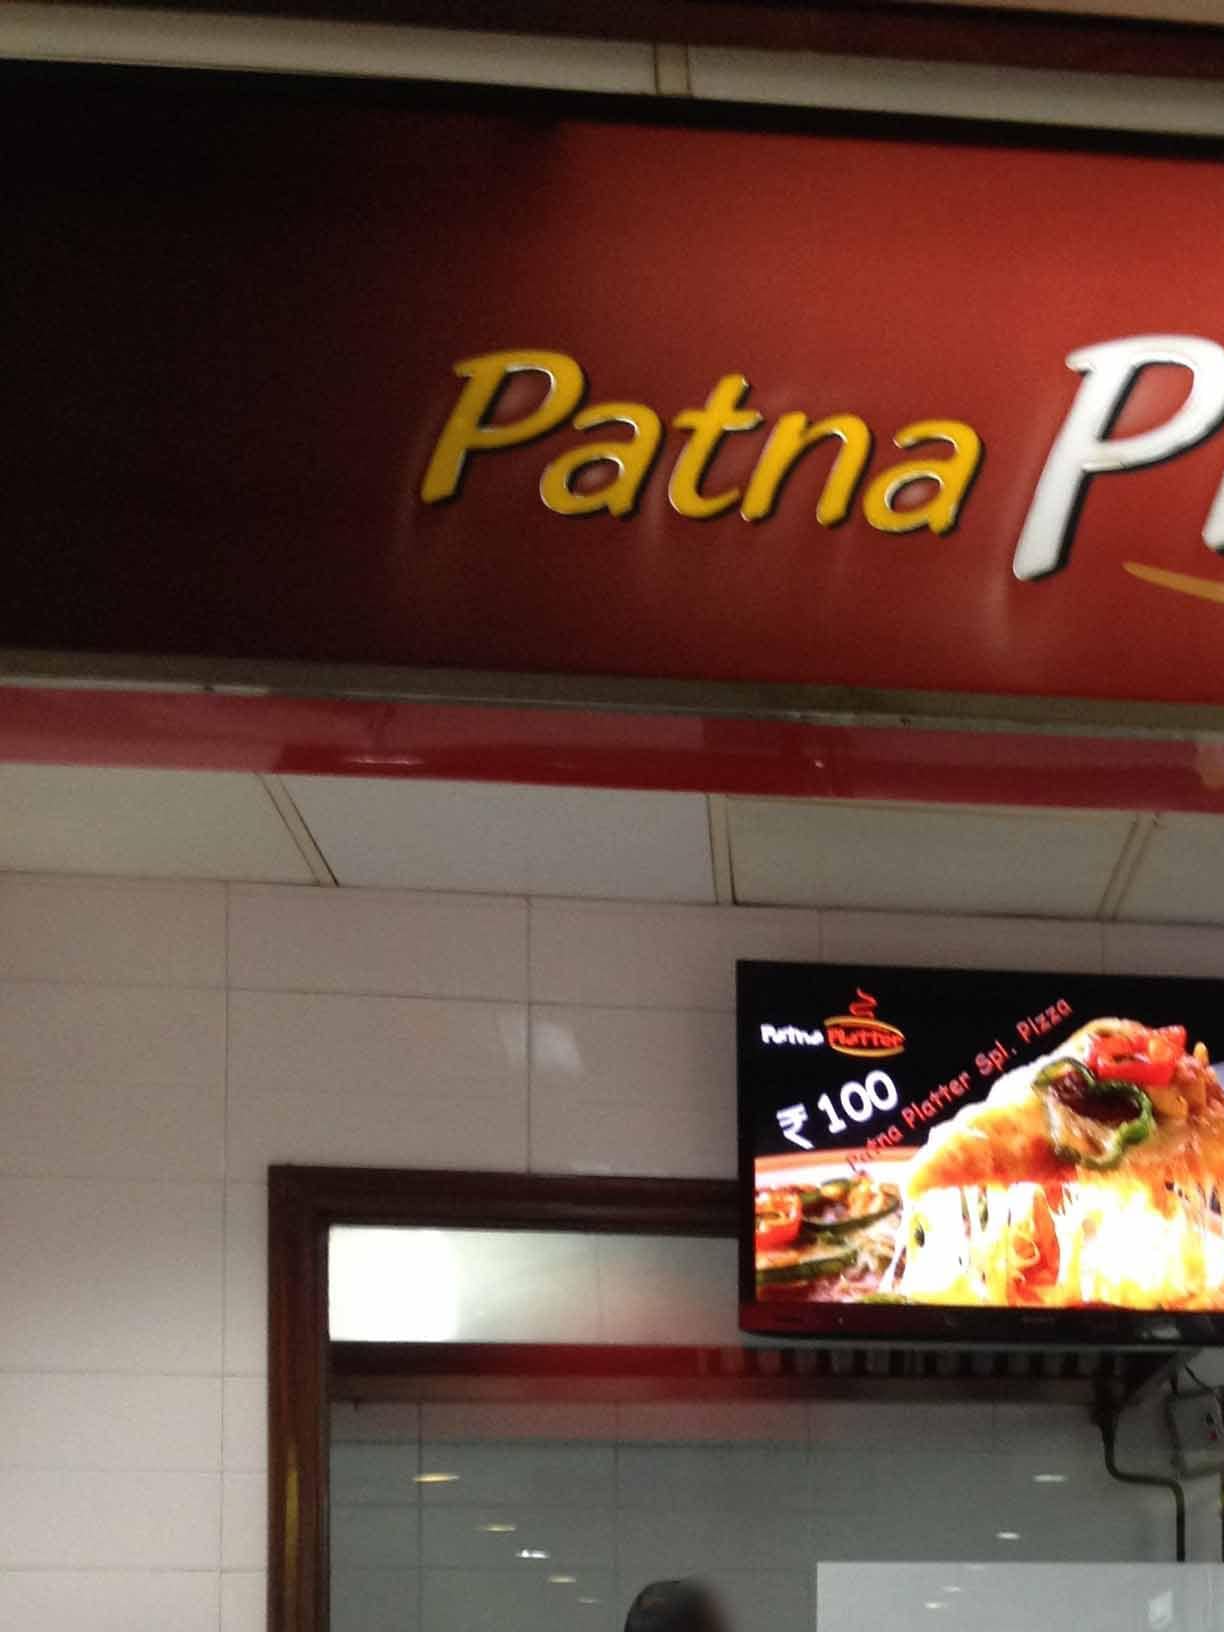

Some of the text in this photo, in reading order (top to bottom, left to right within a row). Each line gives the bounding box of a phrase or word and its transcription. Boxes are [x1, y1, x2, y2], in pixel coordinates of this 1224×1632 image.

[422, 348, 982, 535] Patna
[760, 1023, 824, 1045] Patna
[902, 1070, 972, 1129] Platter
[975, 1040, 1017, 1075] Spl.
[1016, 997, 1073, 1042] Pizza
[817, 1070, 899, 1134] 100
